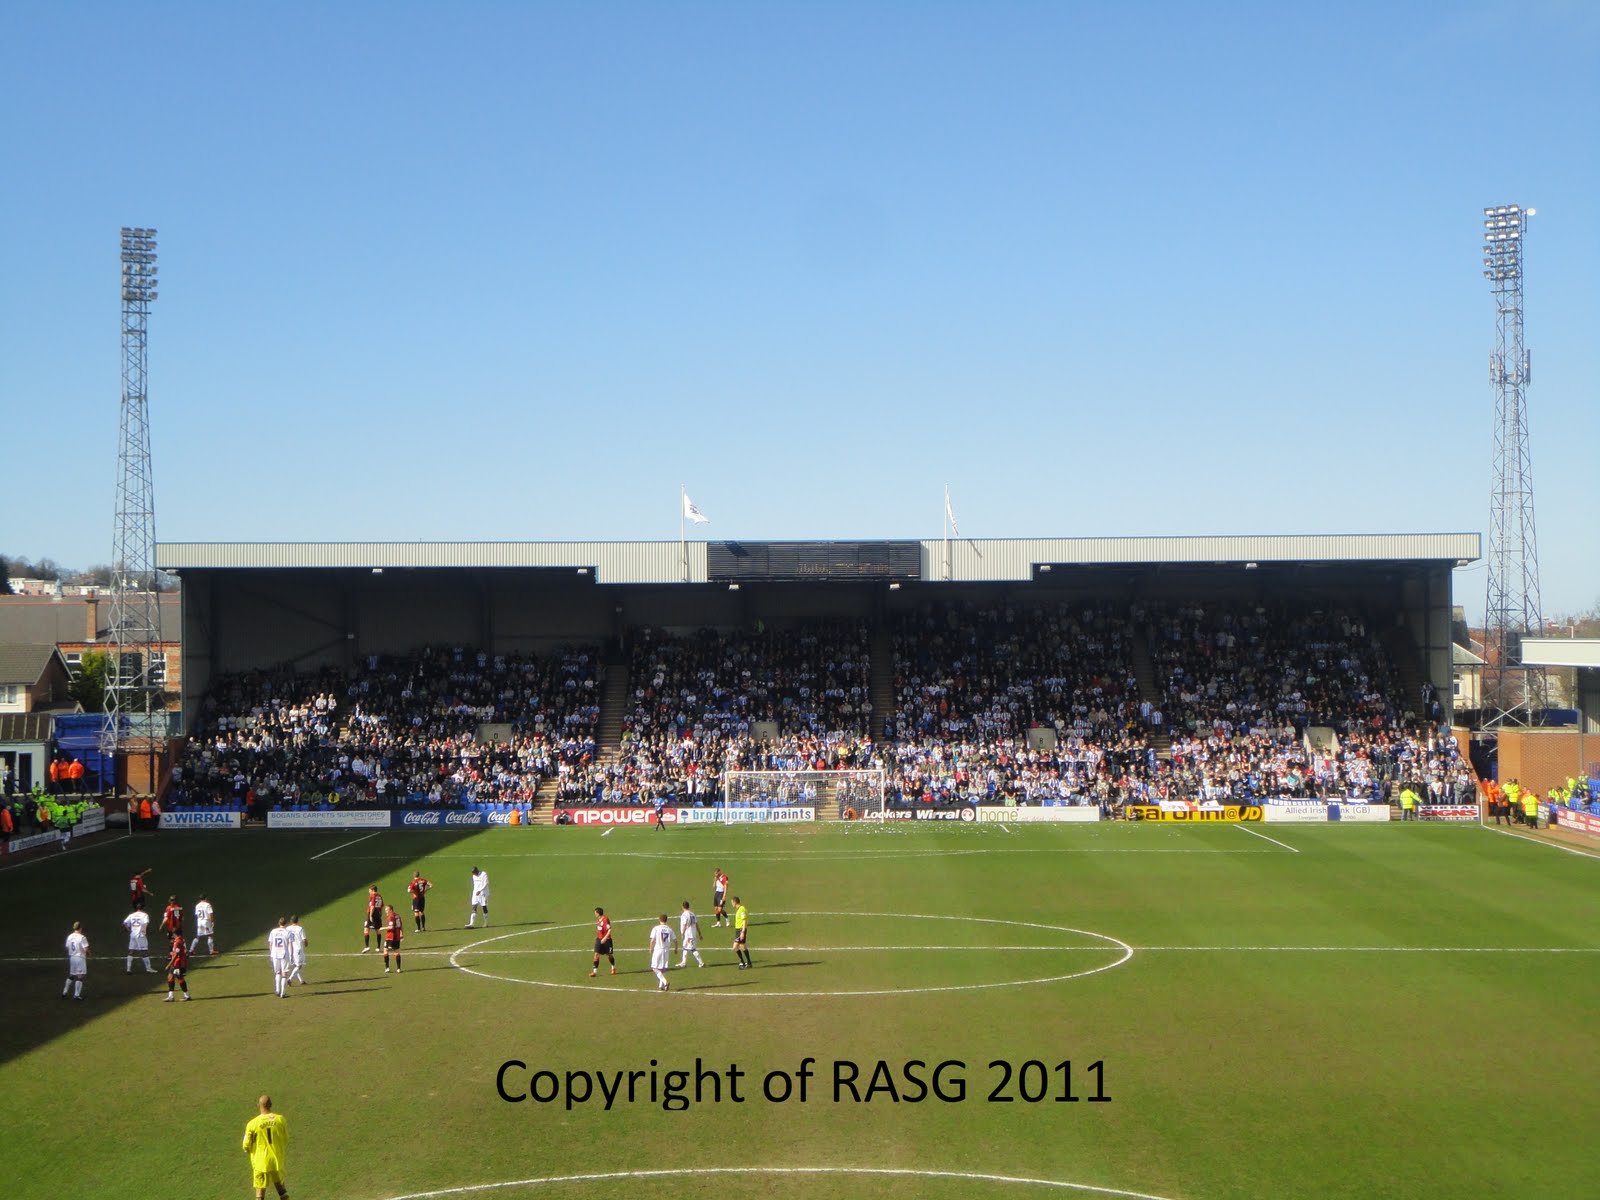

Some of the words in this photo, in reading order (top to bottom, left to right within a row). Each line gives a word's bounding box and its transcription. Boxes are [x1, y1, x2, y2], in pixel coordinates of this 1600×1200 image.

[573, 809, 657, 824] npower
[863, 808, 912, 819] Lookers
[916, 808, 960, 820] Wirral
[980, 807, 1018, 822] home
[1285, 806, 1308, 814] Allied
[1310, 806, 1327, 814] Irish
[1352, 806, 1371, 815] (GB)
[1419, 809, 1478, 817] SIGNS
[174, 813, 234, 823] WIRRAL
[403, 811, 441, 825] Coca-Cola
[445, 811, 483, 825] Coca-Cola
[275, 938, 283, 948] 12
[266, 1127, 273, 1145] 1
